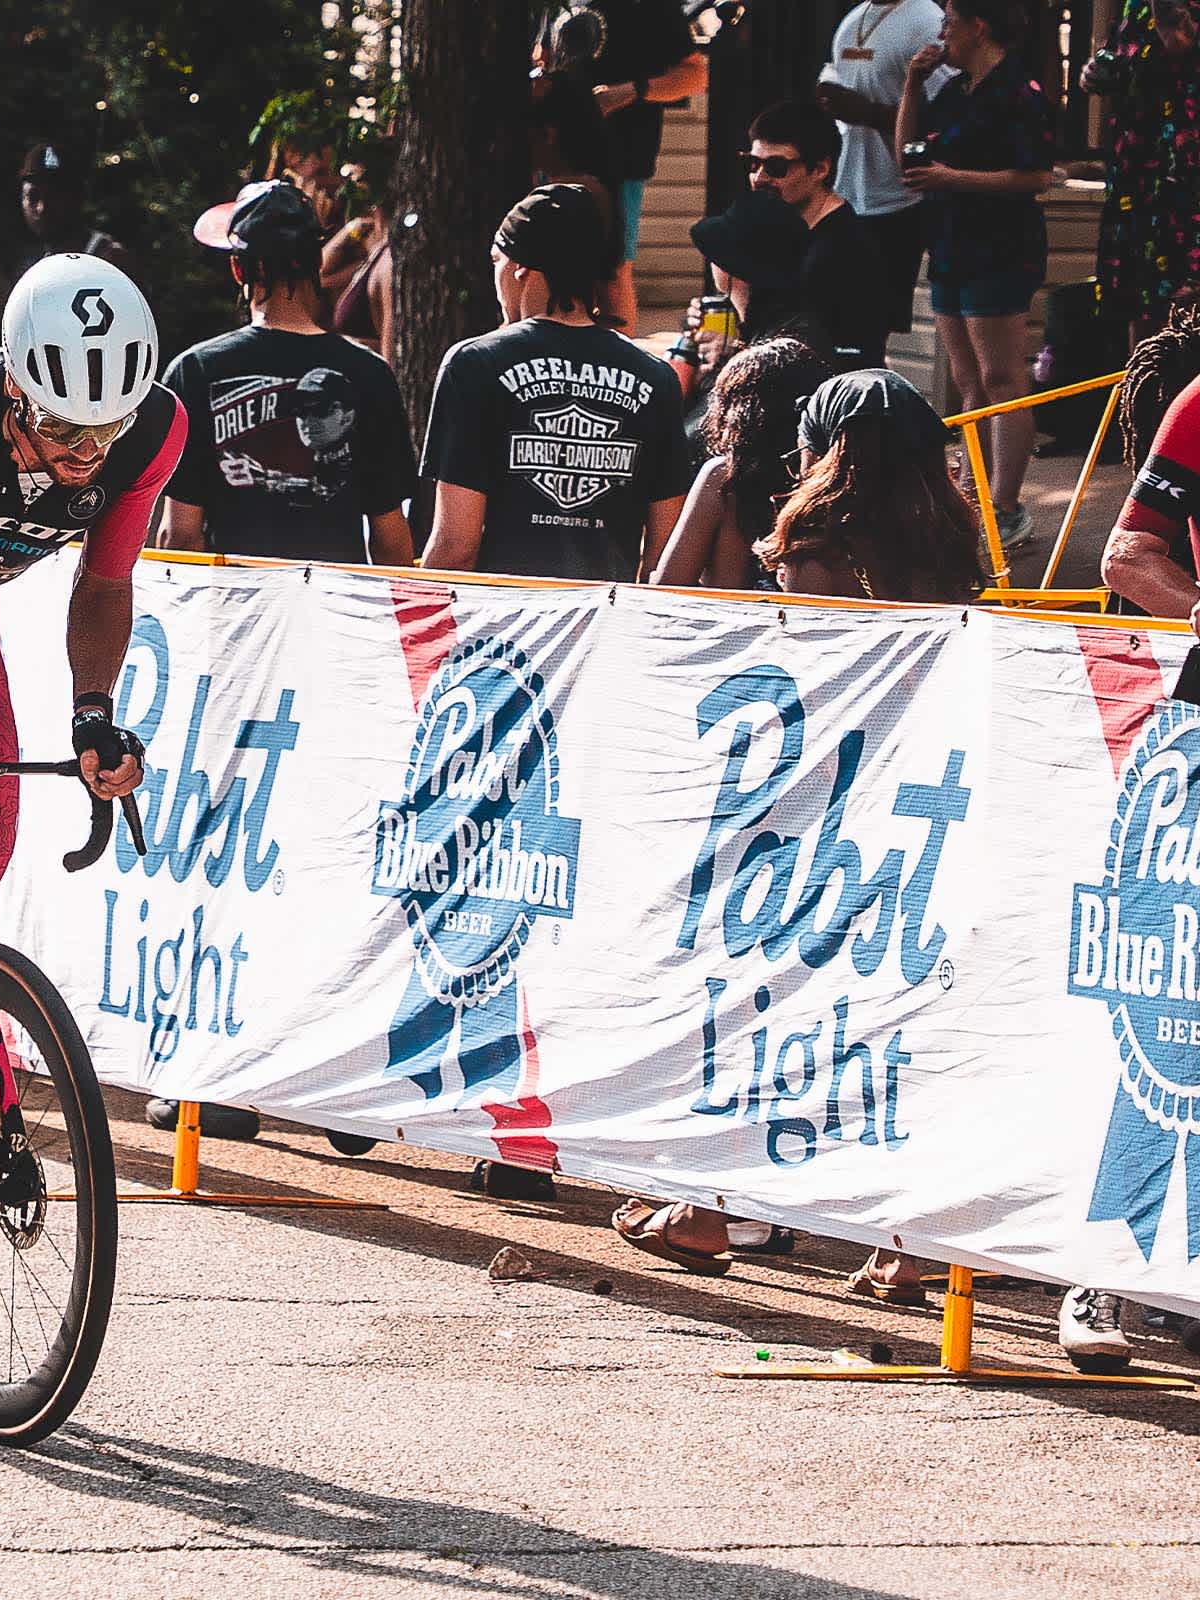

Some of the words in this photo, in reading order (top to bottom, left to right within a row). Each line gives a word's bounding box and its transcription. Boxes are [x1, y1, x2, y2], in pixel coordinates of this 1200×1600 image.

[499, 357, 653, 405] VREELAND'S
[214, 399, 256, 445] DALE
[259, 392, 279, 424] JR
[544, 411, 608, 439] MOTOR
[516, 440, 633, 471] HARLEY-DAVIDSON
[543, 472, 601, 502] CYCLES
[425, 686, 535, 803] Pabst
[676, 664, 971, 986] Pabst
[377, 804, 450, 895] Blue
[450, 816, 570, 908] Ribbon
[443, 909, 493, 937] BEER
[1073, 892, 1164, 999] Blue
[98, 888, 249, 1064] Light
[1156, 1015, 1200, 1046] BEE
[690, 976, 912, 1169] Light
